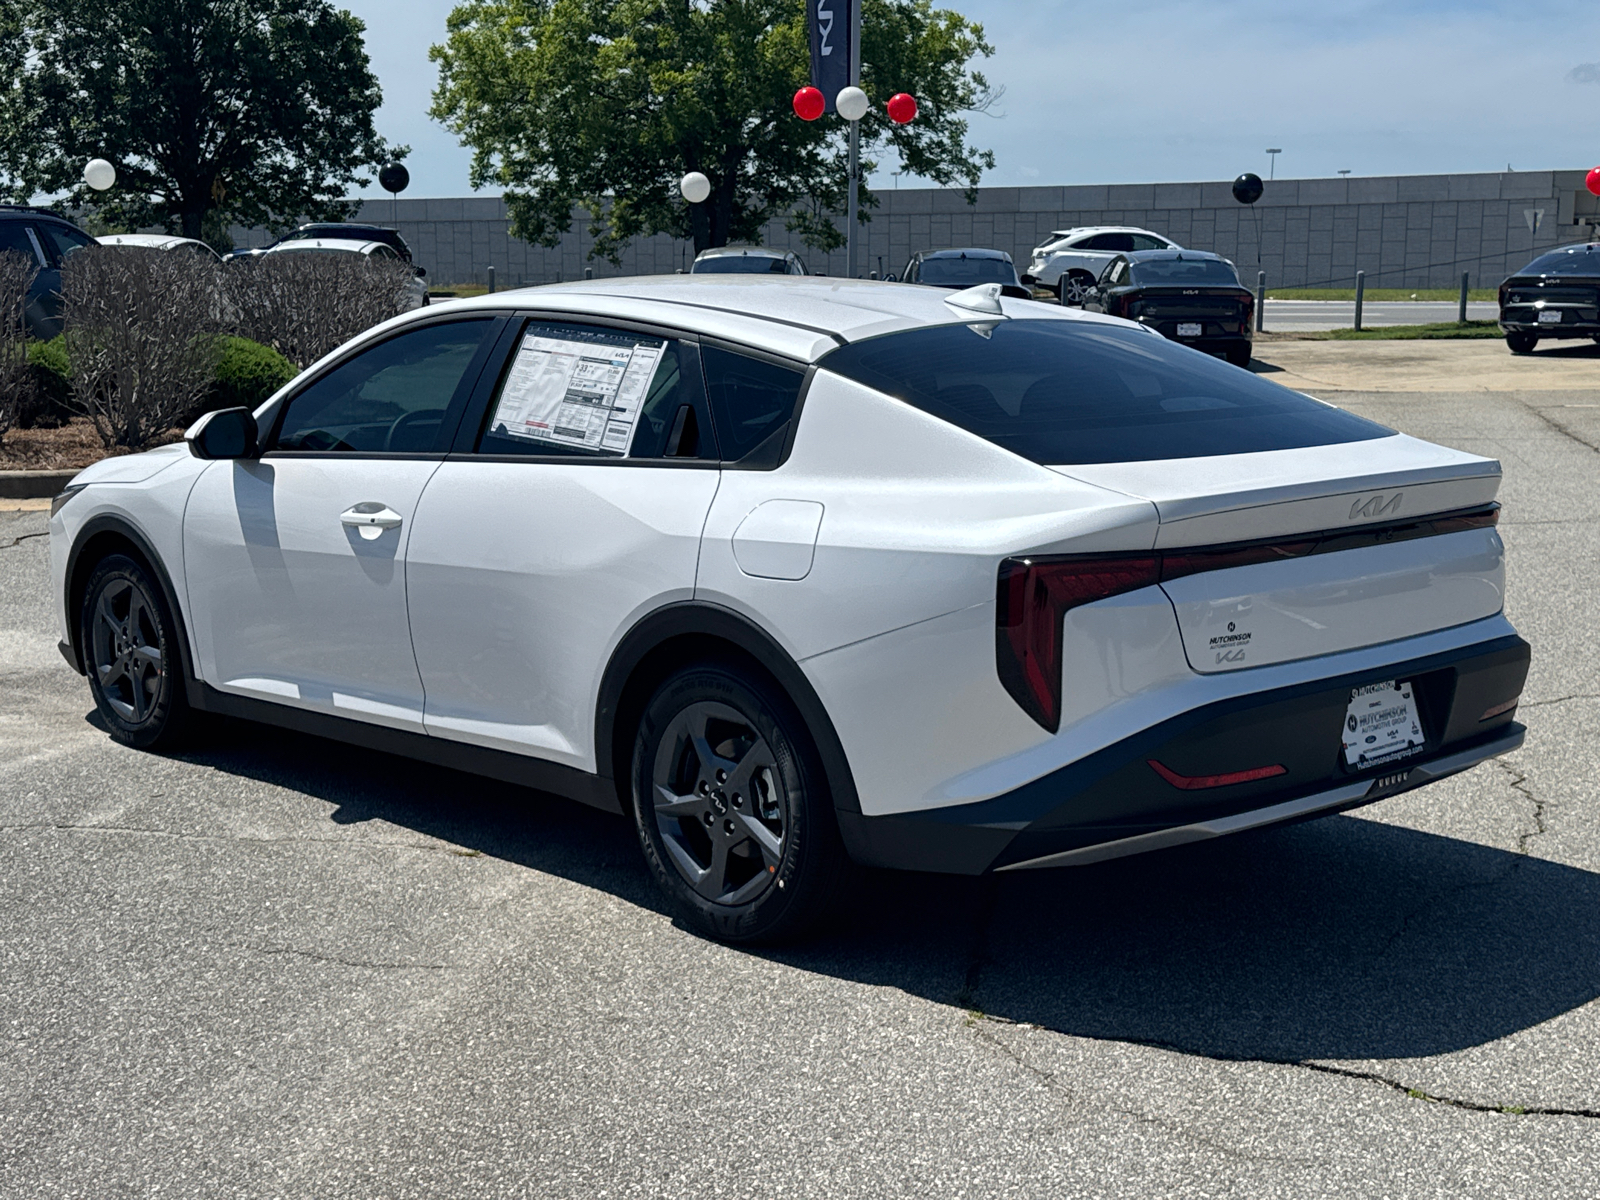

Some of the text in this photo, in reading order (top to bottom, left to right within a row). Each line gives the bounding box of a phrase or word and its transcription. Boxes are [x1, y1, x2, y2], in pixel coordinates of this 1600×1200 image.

[1348, 492, 1404, 520] KIA
[1209, 632, 1252, 645] HUTCHINSON
[1210, 642, 1236, 650] AUTOMOTIVE
[1215, 648, 1246, 665] K4
[1359, 704, 1408, 727] HUTCHINSON
[1361, 716, 1407, 734] AUTOMOTIVE GROUP
